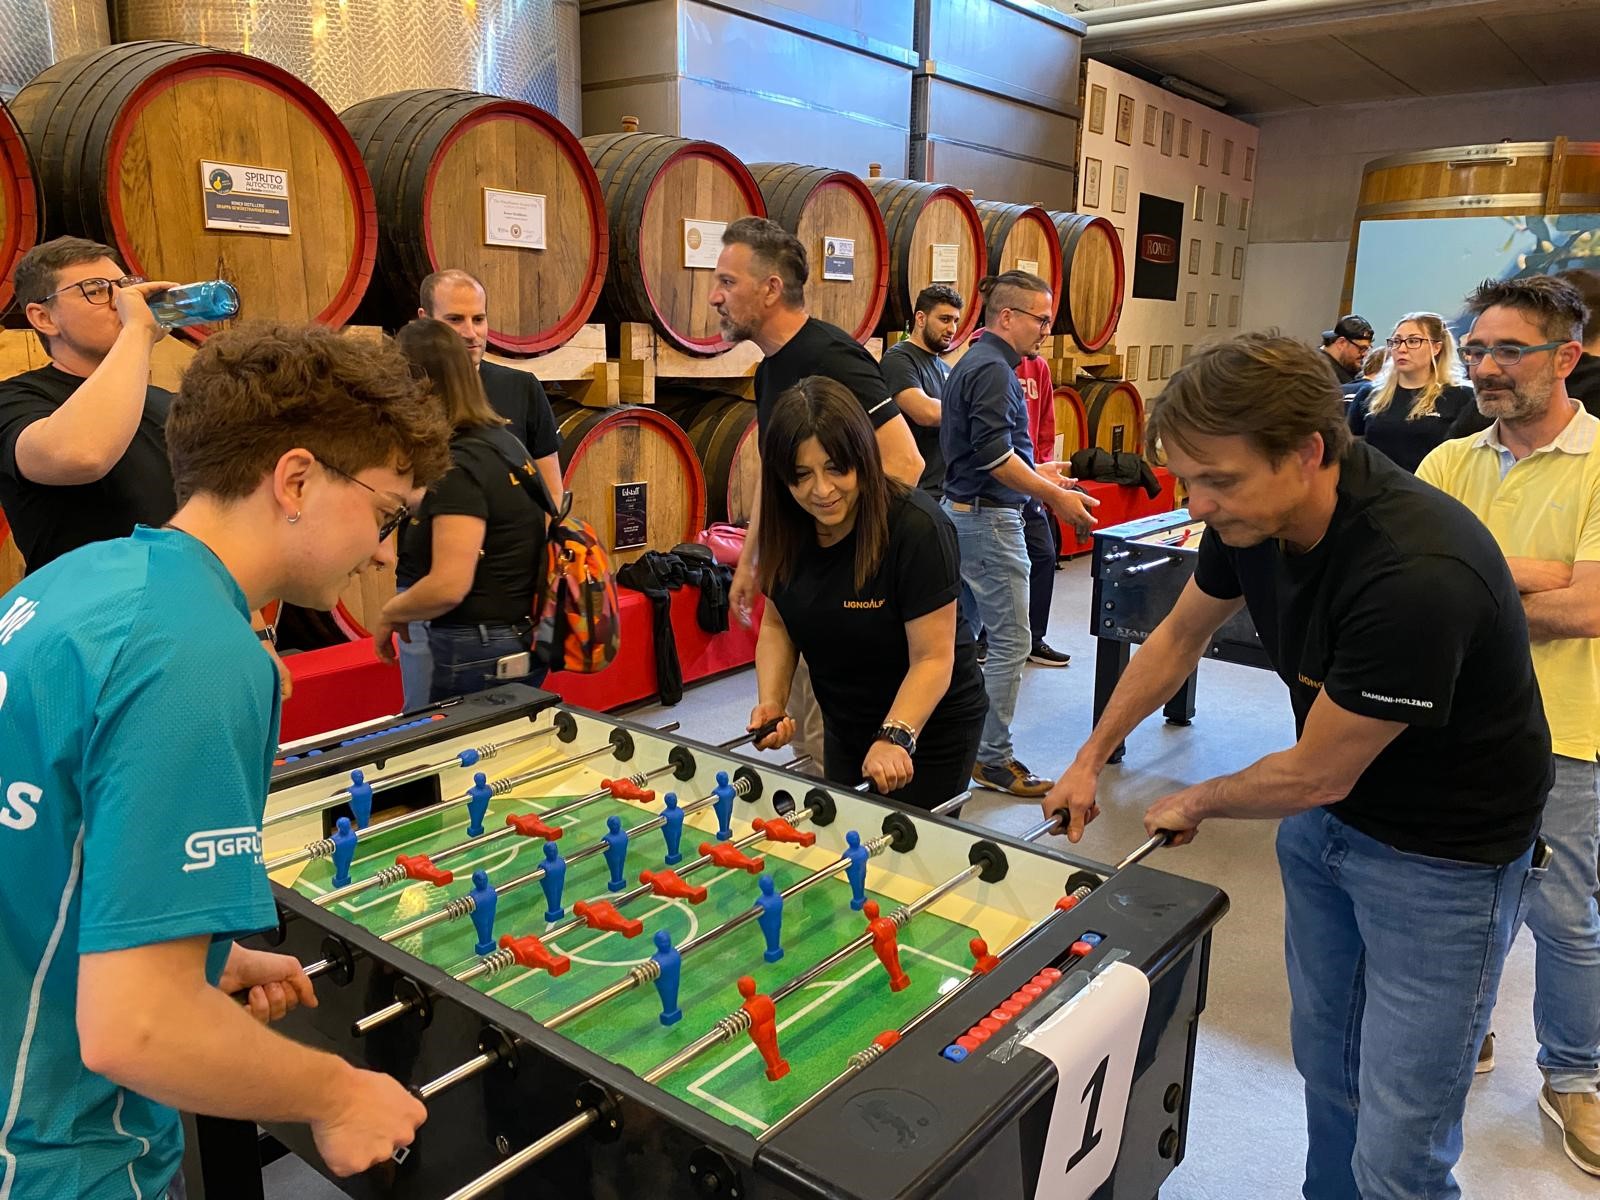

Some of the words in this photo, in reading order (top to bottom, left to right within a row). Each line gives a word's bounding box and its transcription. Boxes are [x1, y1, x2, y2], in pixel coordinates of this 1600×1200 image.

[245, 171, 283, 185] SPIRITO
[246, 181, 283, 191] AUTOCTONO
[1065, 1054, 1110, 1174] 1
